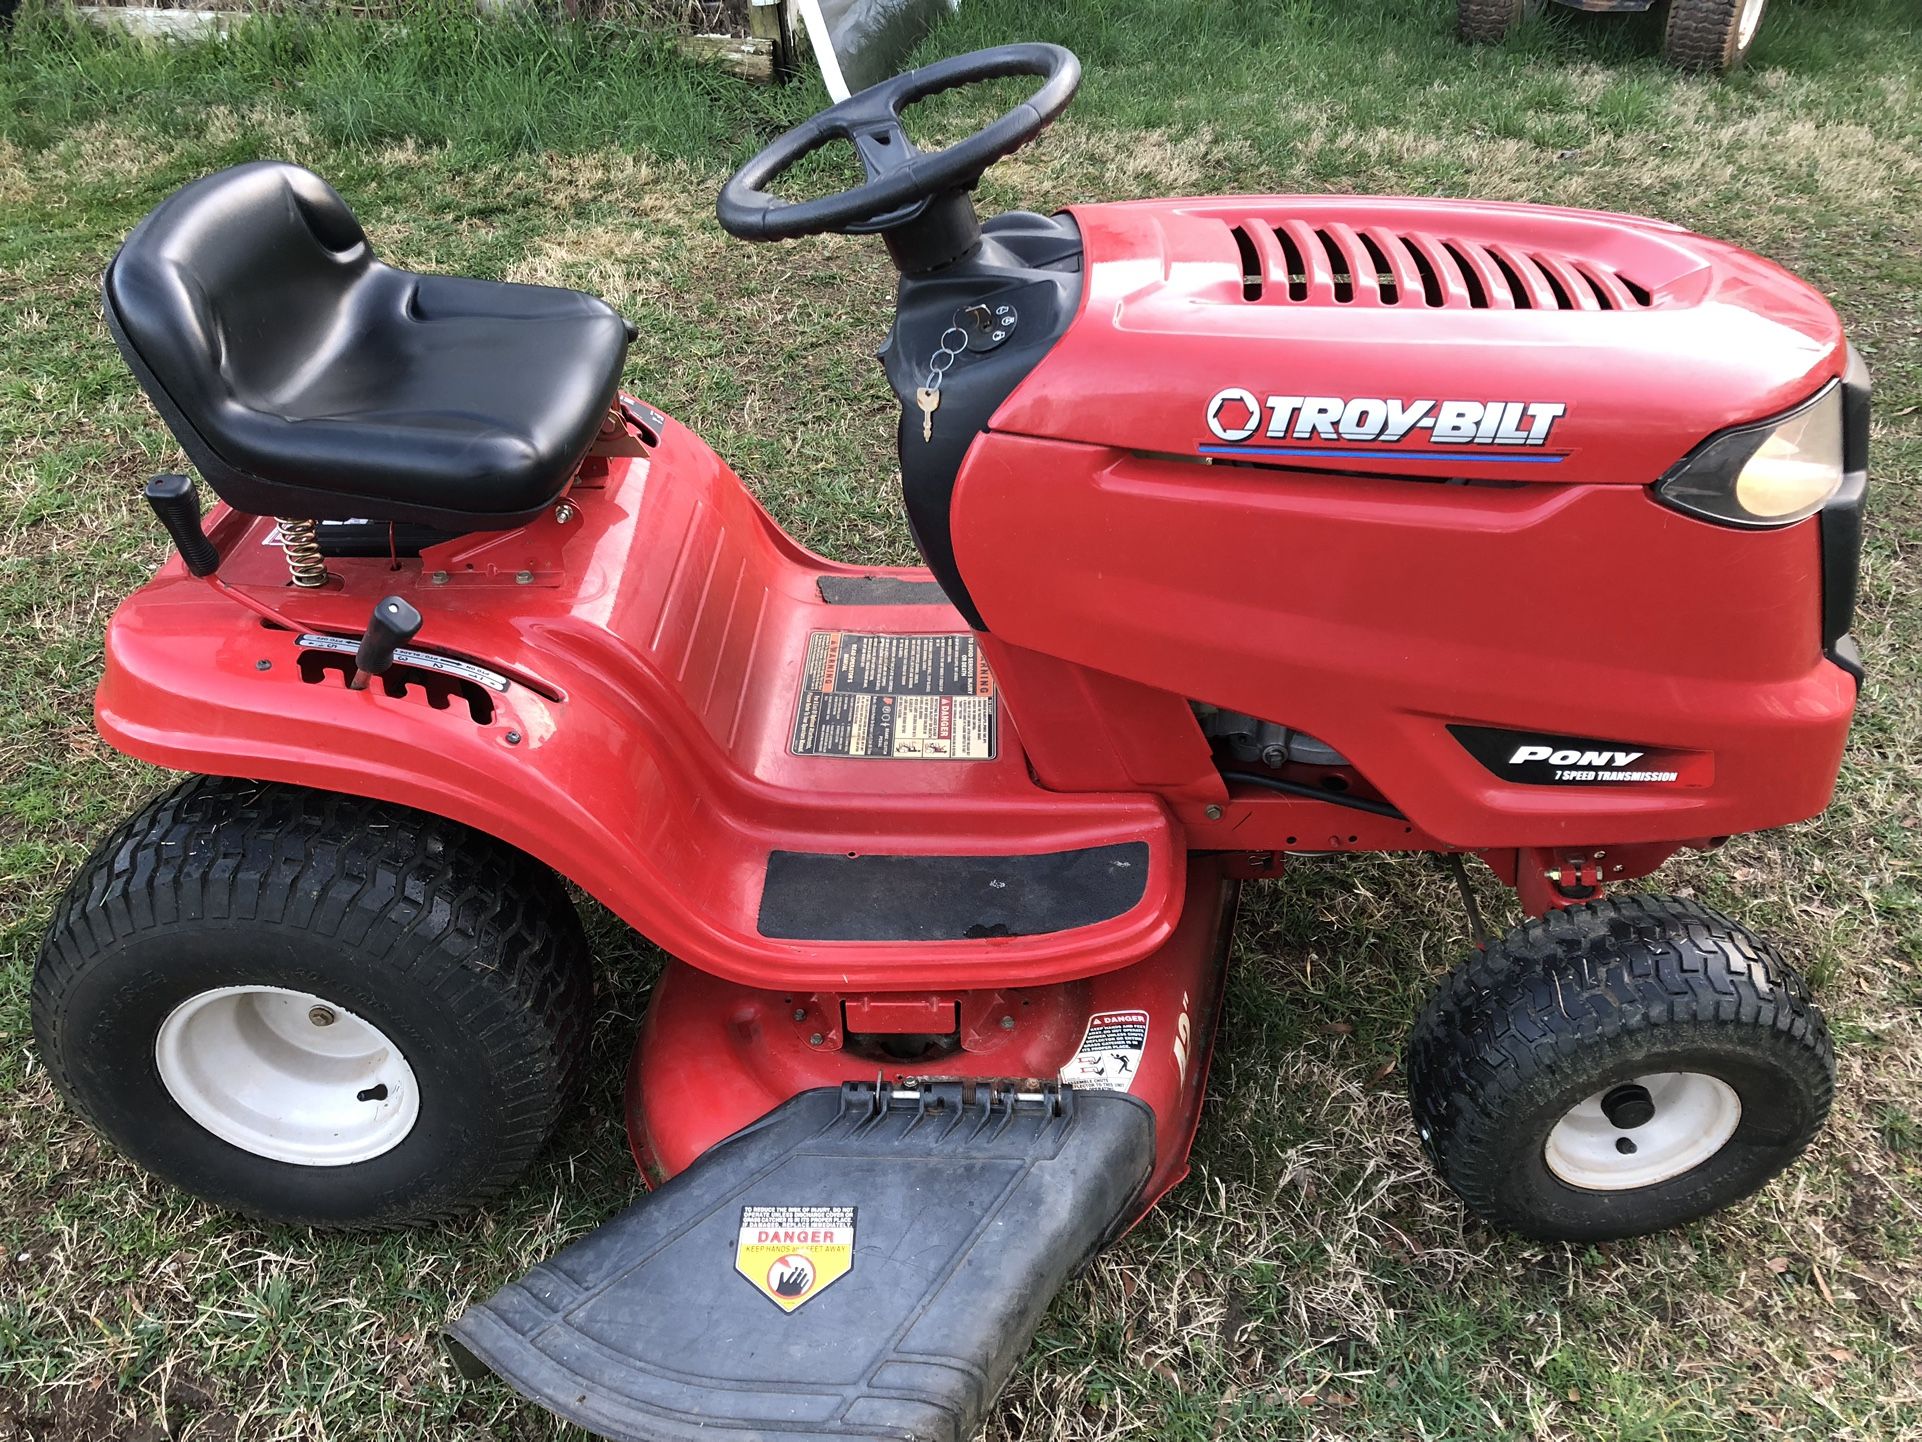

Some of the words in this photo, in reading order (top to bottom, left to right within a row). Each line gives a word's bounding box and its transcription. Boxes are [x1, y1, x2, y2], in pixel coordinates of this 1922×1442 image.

[1264, 395, 1566, 446] TROY-BILT
[825, 646, 838, 684] WARNING
[980, 655, 989, 694] ARNING
[940, 705, 950, 736] DANGER
[1555, 770, 1562, 780] 7
[1562, 771, 1595, 781] SPEED
[1597, 771, 1678, 782] TRANSMISSION
[1104, 1015, 1145, 1023] DANGER
[757, 1231, 835, 1243] DANGER
